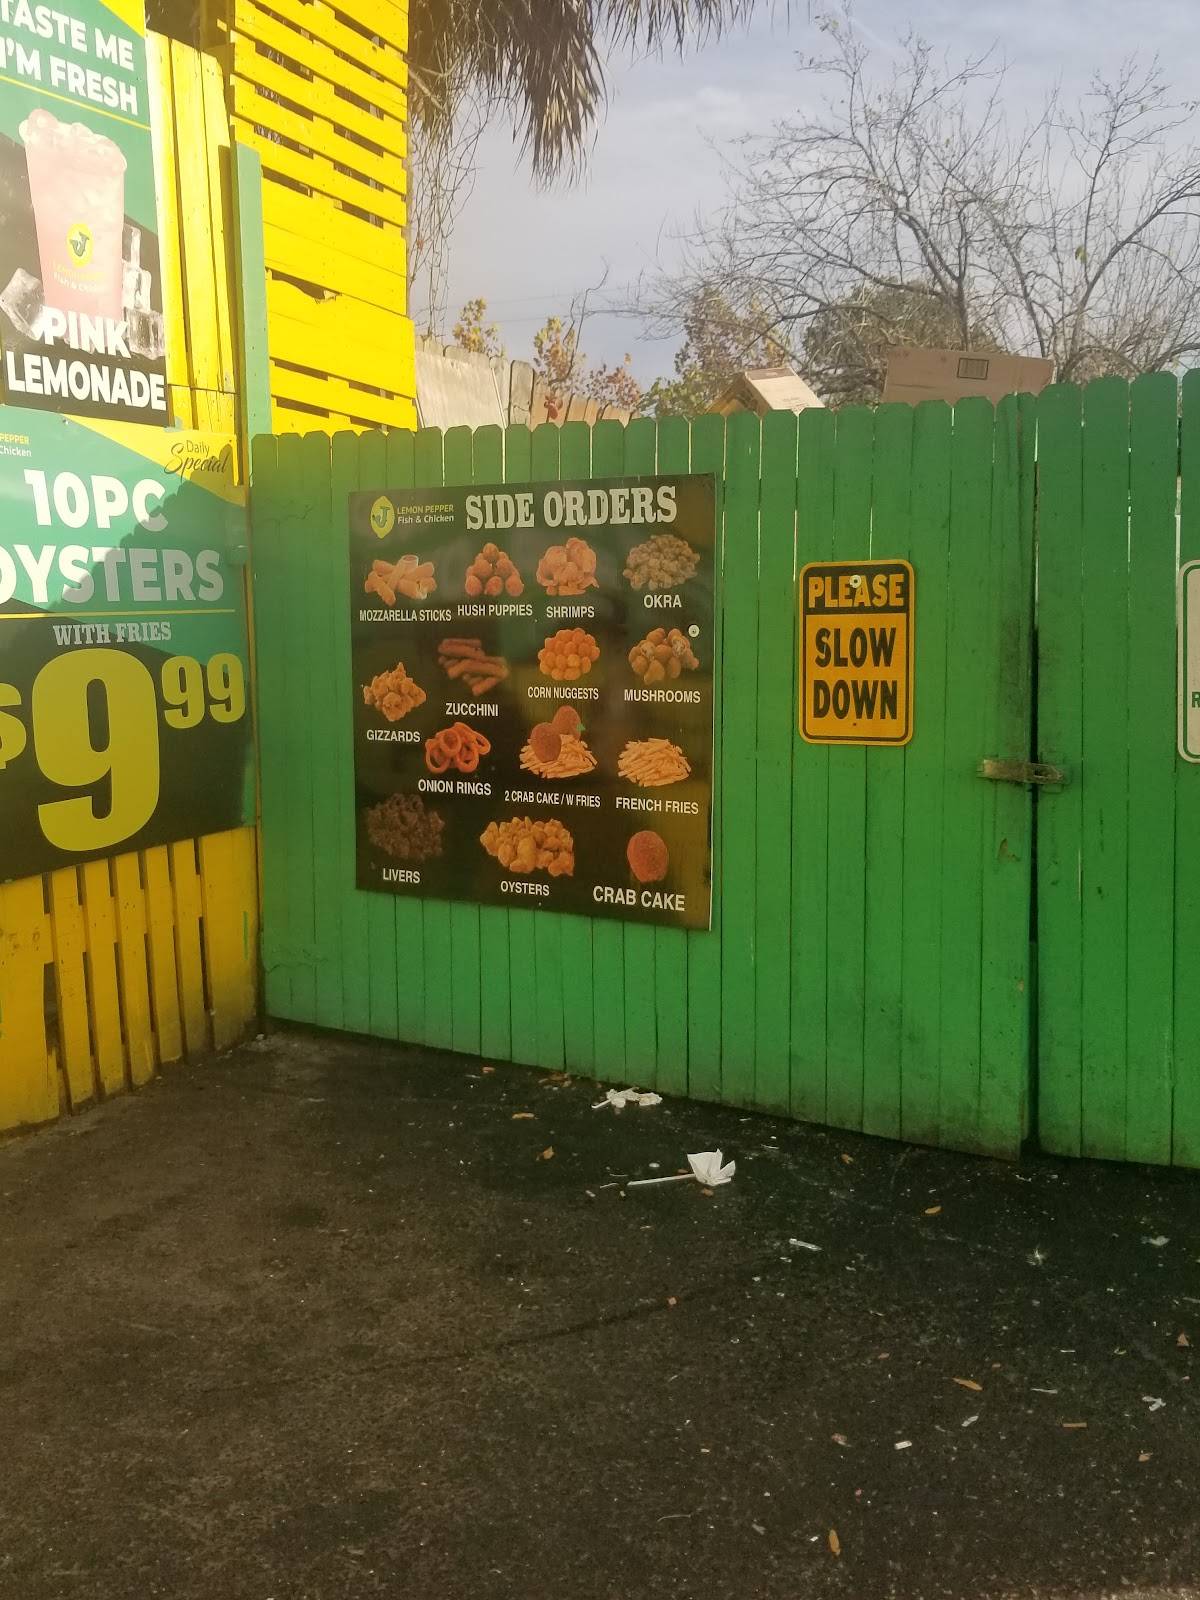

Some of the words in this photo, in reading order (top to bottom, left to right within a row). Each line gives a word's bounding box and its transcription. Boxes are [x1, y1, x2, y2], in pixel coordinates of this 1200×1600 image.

[0, 0, 87, 53] TASTE
[95, 27, 134, 71] ME
[50, 55, 138, 116] FRESH
[43, 309, 132, 358] PINK
[6, 351, 167, 411] LEMONADE
[186, 440, 210, 458] Daily
[164, 443, 229, 484] Special
[24, 468, 168, 531] 10PC
[425, 504, 454, 513] PEPPER
[465, 493, 535, 530] SIDE
[543, 485, 678, 528] ORDERS
[397, 516, 413, 524] Fish
[415, 515, 421, 523] &
[423, 515, 455, 523] Chicken
[808, 573, 905, 608] PLEASE
[457, 604, 486, 617] HUSH
[488, 604, 533, 617] PUPPIES
[643, 595, 682, 608] OKRA
[359, 609, 418, 622] MOZZARELLA
[419, 609, 452, 622] STICKS
[546, 606, 595, 618] SHRIMPS
[53, 625, 112, 645] WITH
[116, 622, 172, 643] FRIES
[815, 627, 897, 668] SLOW
[161, 652, 247, 729] 99
[527, 686, 552, 699] CORN
[553, 687, 599, 700] NUGGESTS
[624, 689, 701, 704] MUSHROOMS
[813, 679, 898, 720] DOWN
[445, 703, 499, 717] ZUCCHINI
[366, 729, 421, 743] GIZZARDS
[418, 779, 454, 794] ONION
[456, 781, 492, 796] RINGS
[504, 790, 510, 802] 2
[511, 791, 535, 803] CRAB
[536, 793, 560, 805] CAKE
[575, 795, 601, 808] FRIES
[615, 796, 662, 812] FRENCH
[665, 800, 699, 815] FRIES
[382, 867, 421, 884] LIVERS
[500, 880, 550, 896] OYSTERS
[593, 885, 637, 906] CRAB
[640, 890, 686, 912] CAKE
